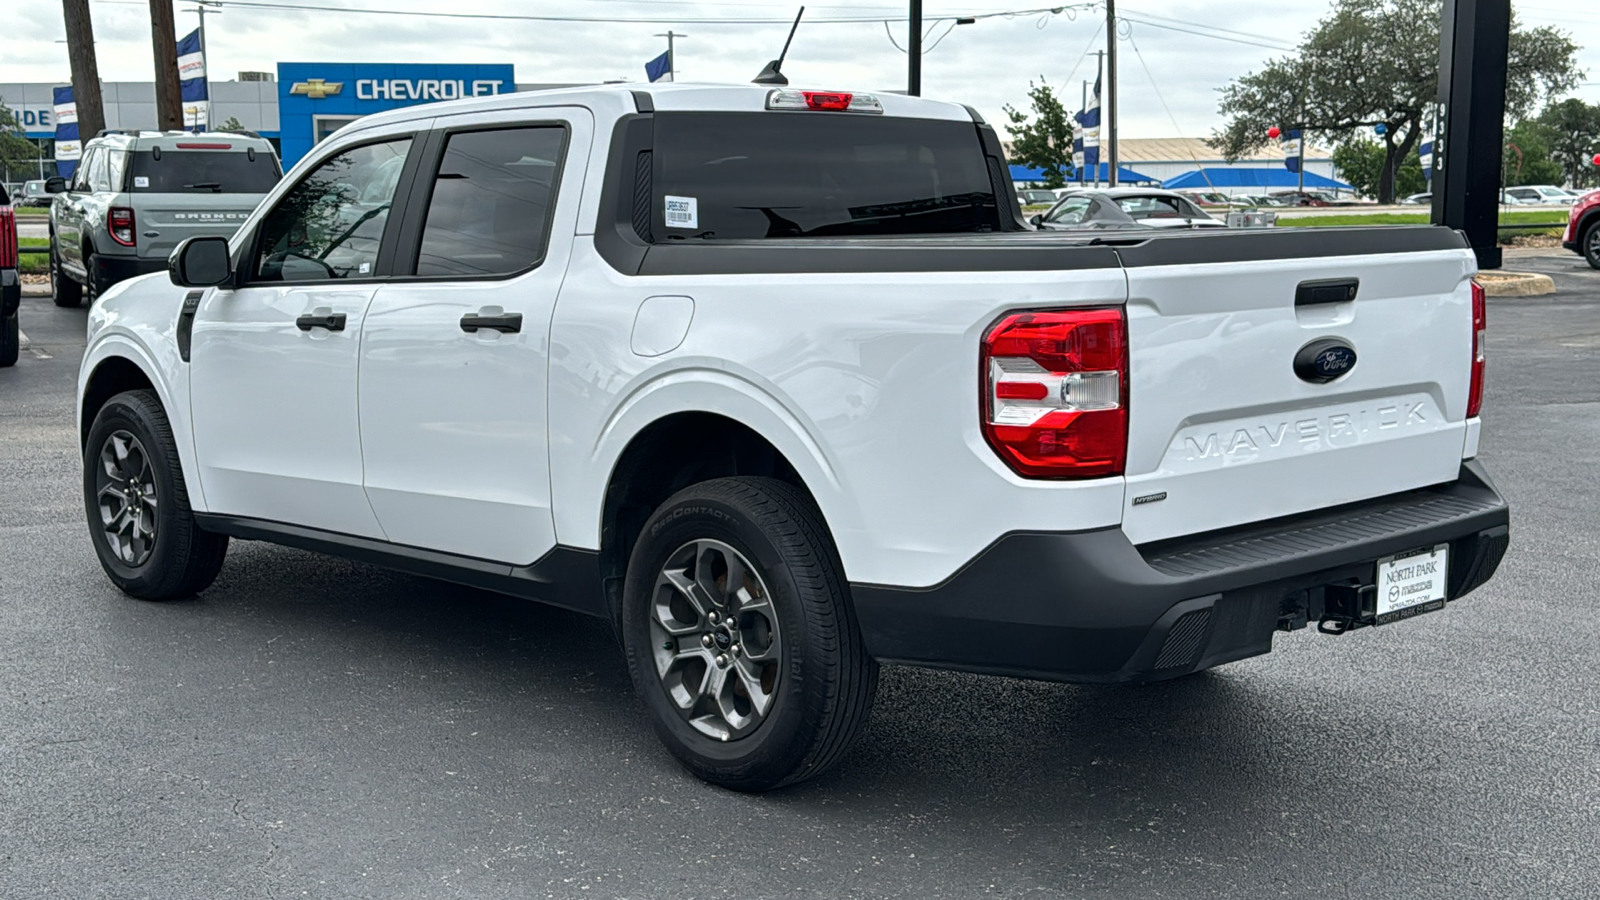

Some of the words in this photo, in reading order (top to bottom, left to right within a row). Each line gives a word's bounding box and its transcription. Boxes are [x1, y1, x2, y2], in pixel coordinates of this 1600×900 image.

[356, 79, 504, 100] CHEVROLET
[15, 110, 51, 126] IDE
[1437, 103, 1446, 170] 9333
[1317, 351, 1352, 371] Ford
[1184, 401, 1428, 461] MAVERICK
[1135, 493, 1166, 504] HYBRID
[1386, 566, 1415, 585] NORTH
[1416, 561, 1437, 577] PARK
[1378, 612, 1400, 624] NORTH
[1400, 607, 1416, 619] PARK
